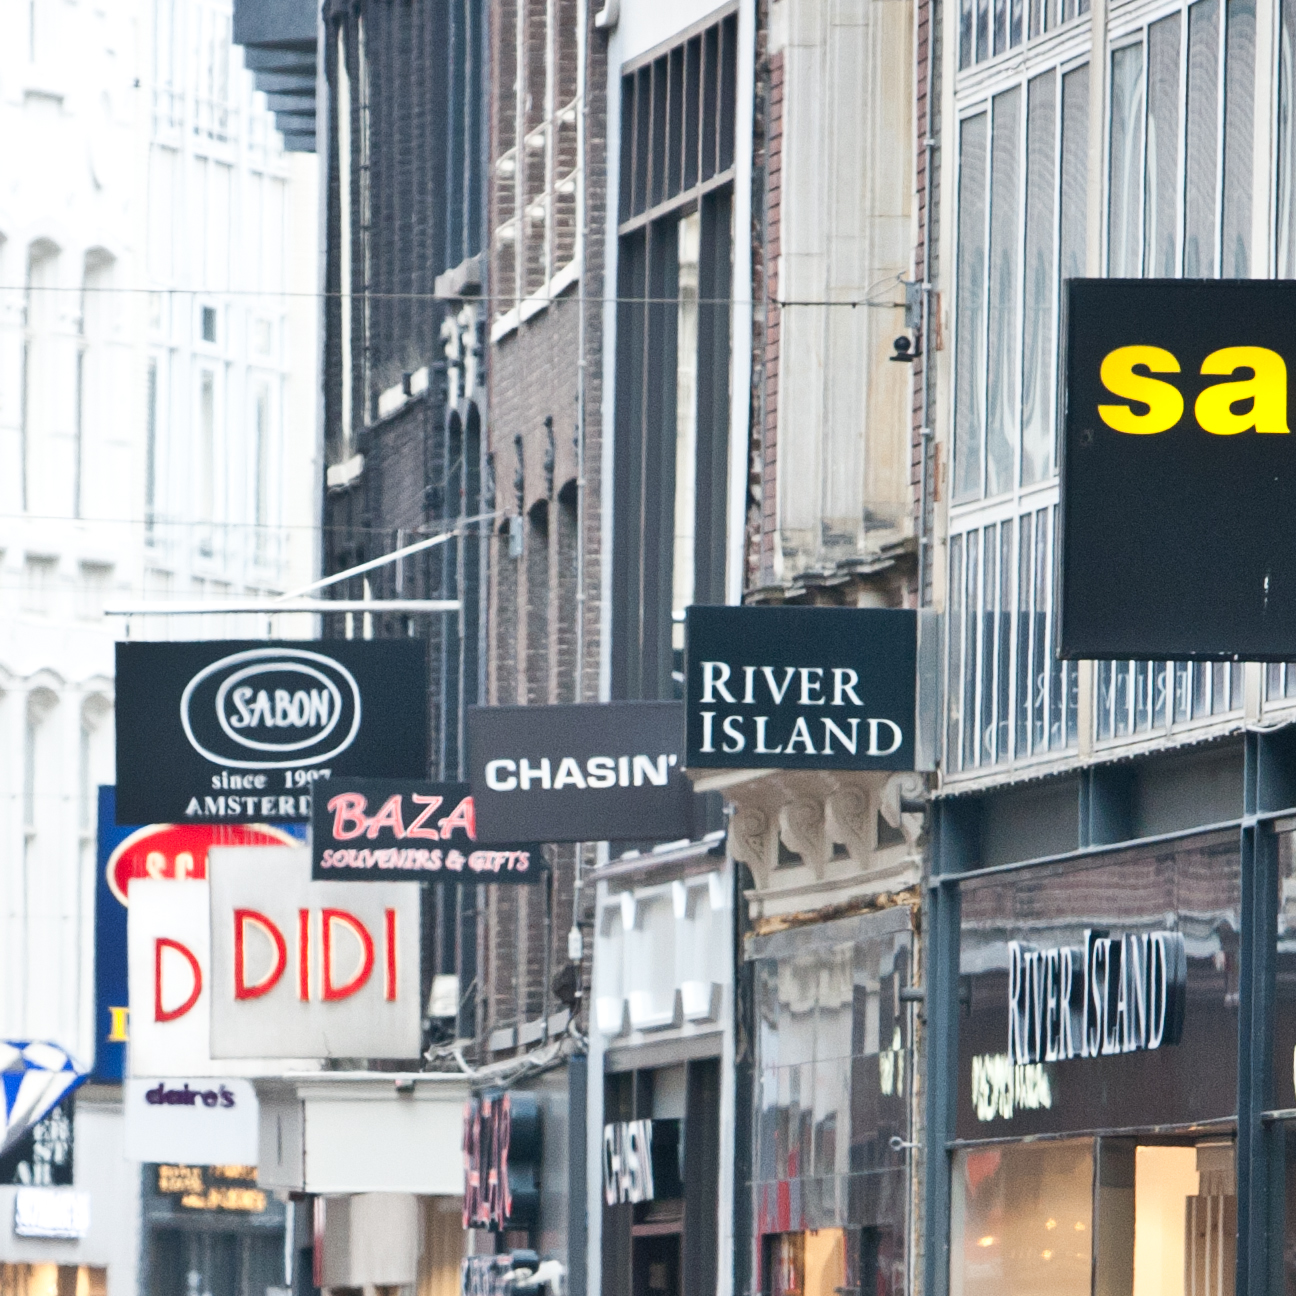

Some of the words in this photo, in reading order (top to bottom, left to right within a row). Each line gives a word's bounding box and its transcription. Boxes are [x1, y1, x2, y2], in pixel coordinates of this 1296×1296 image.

[700, 661, 864, 706] RIVER
[230, 686, 331, 729] SABON
[699, 711, 903, 757] ISLAND
[211, 768, 268, 790] since
[484, 753, 677, 792] CHASIN'
[184, 795, 312, 817] AMSTERD
[327, 791, 477, 842] BAZA
[320, 847, 442, 873] SOUVENIRS
[445, 849, 466, 873] &
[468, 849, 532, 873] GIFTS
[233, 907, 397, 1001] DIDI
[1008, 940, 1075, 1067] RIVER
[1080, 927, 1167, 1058] ISLAND
[144, 1075, 236, 1108] claire's
